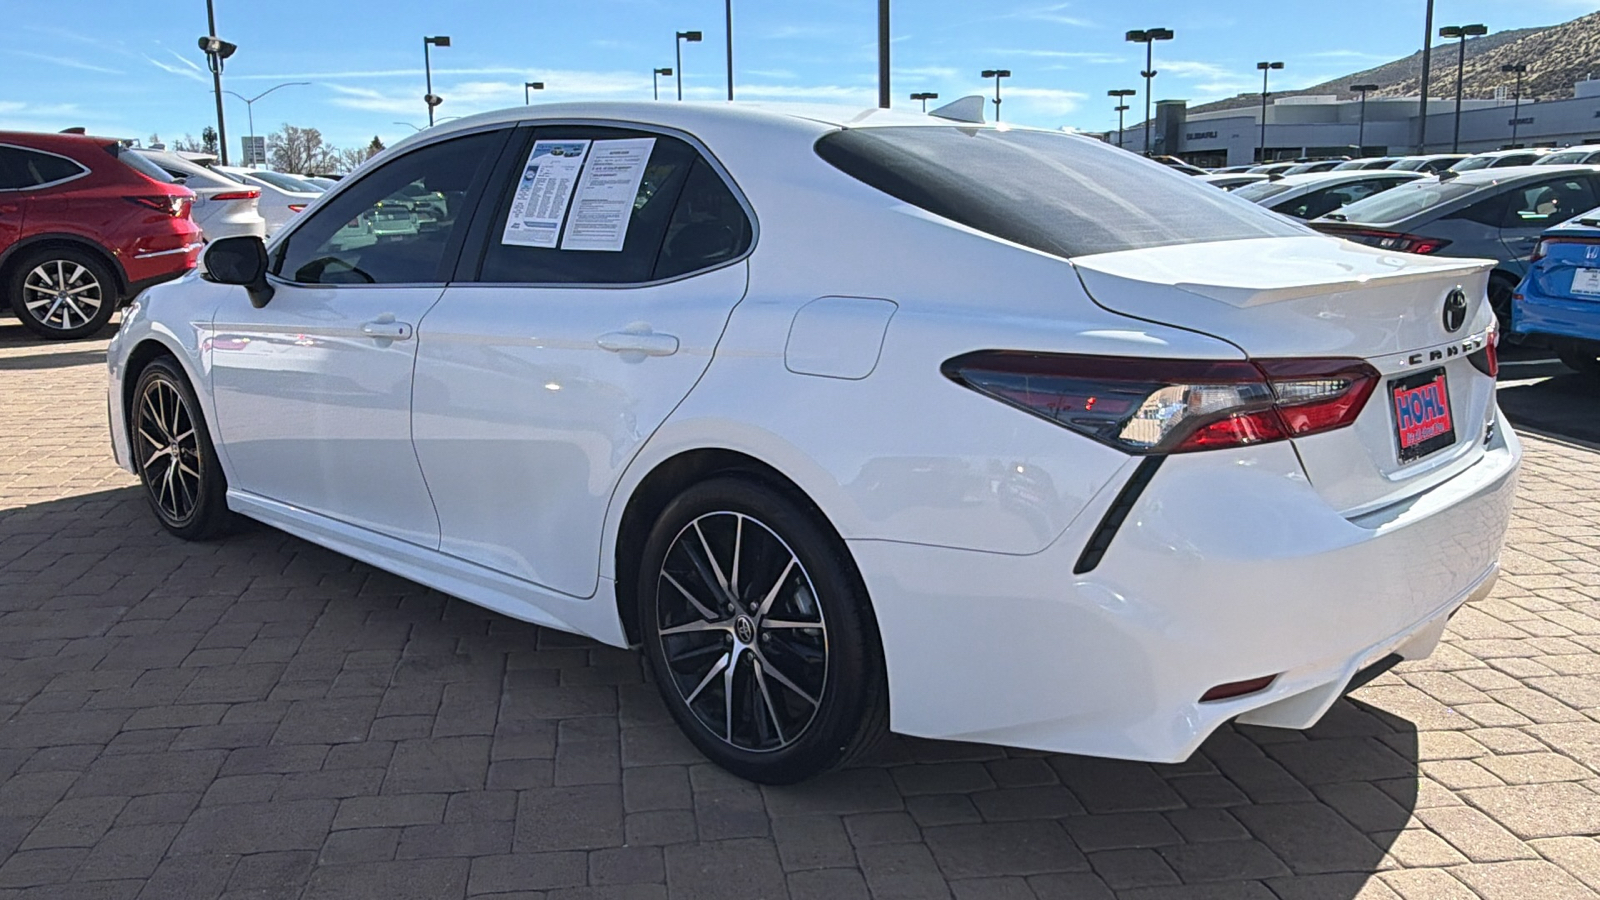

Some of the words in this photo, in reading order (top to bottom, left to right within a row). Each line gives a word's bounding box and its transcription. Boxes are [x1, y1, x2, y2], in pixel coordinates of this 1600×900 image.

[1186, 131, 1217, 141] SUBARU
[1408, 337, 1483, 365] CAMRY
[1397, 386, 1445, 429] HOHL
